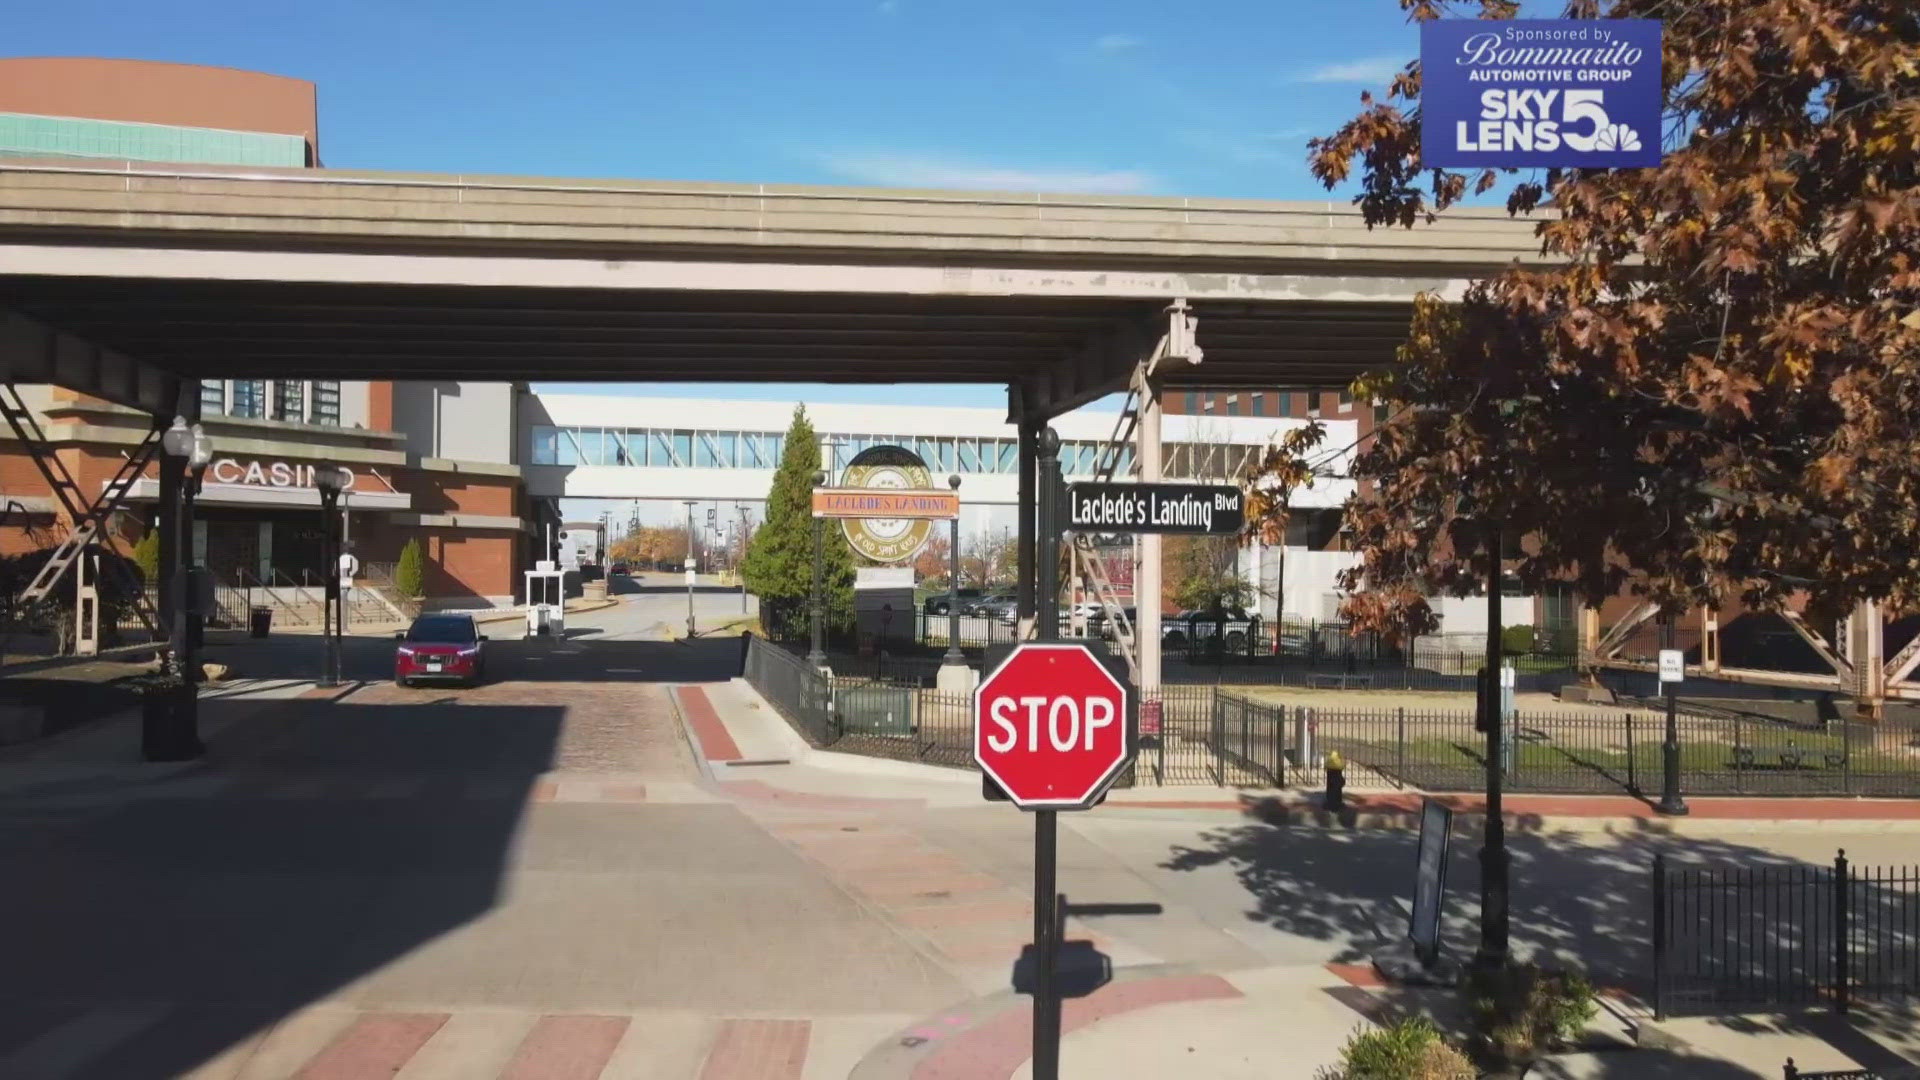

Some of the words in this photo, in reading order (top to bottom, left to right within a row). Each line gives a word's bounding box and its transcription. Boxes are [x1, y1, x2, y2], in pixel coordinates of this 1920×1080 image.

[895, 496, 947, 511] LANDING
[1072, 491, 1146, 525] Laclede's
[1151, 492, 1212, 533] Landing
[1214, 493, 1238, 511] Blvd
[987, 695, 1114, 754] STOP
